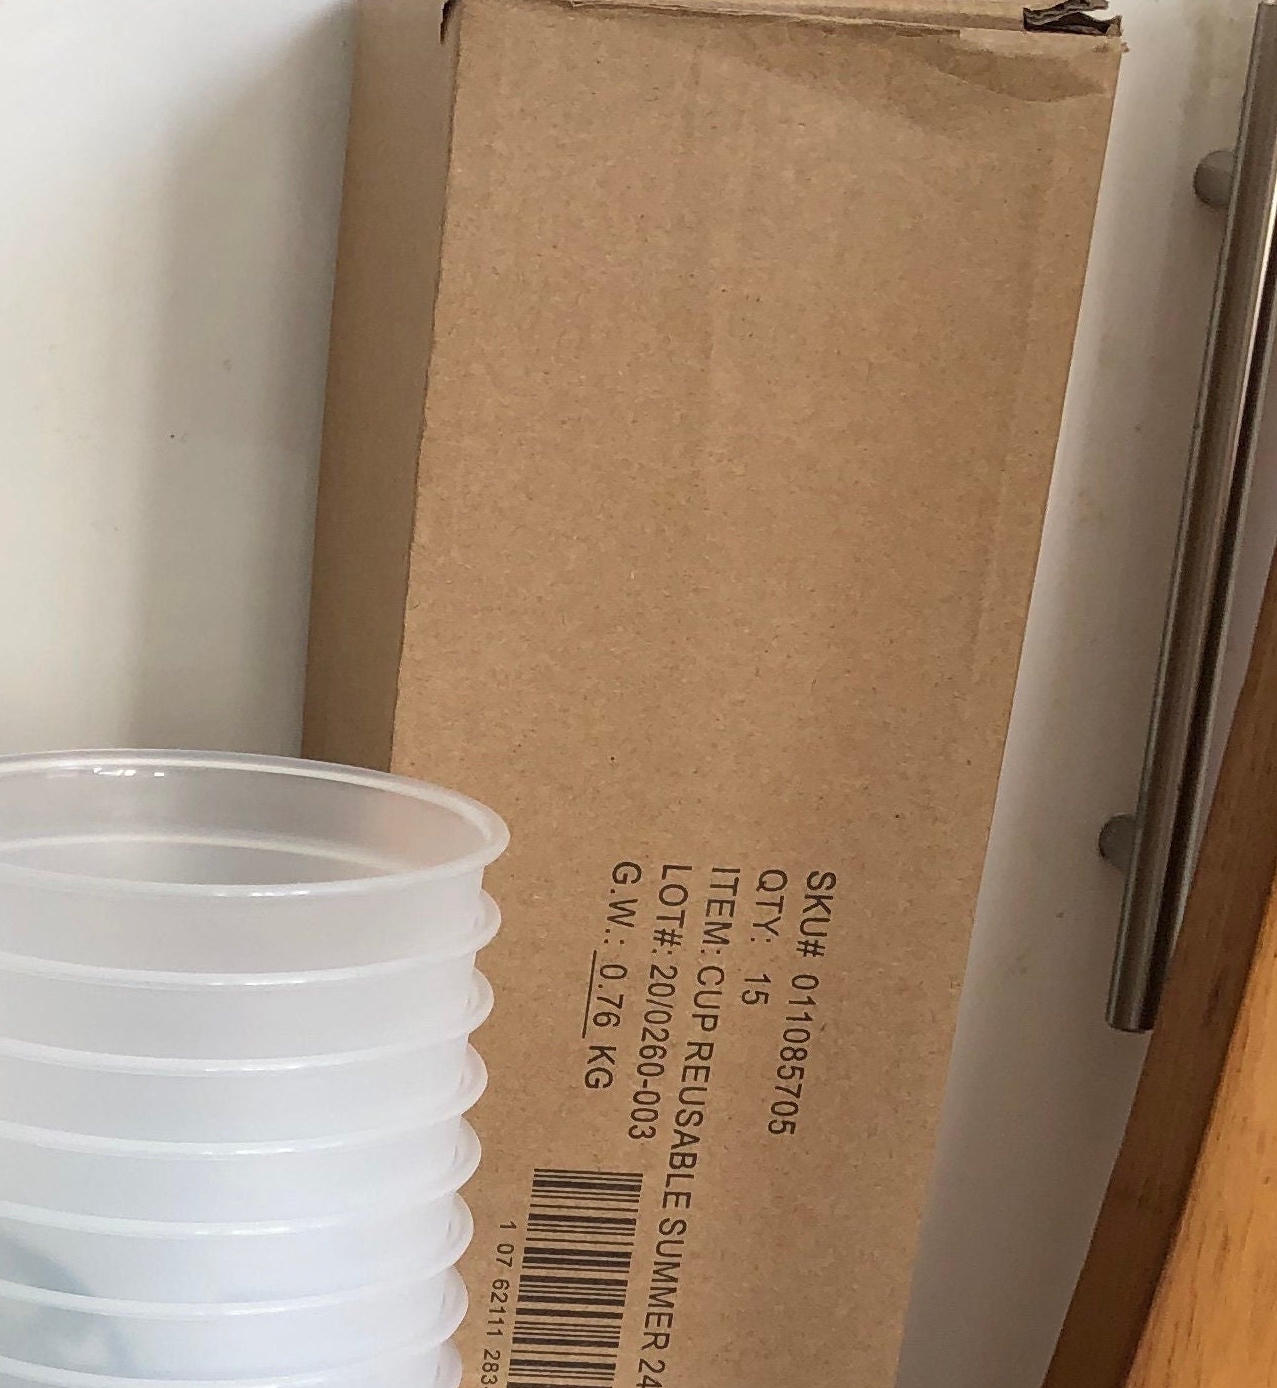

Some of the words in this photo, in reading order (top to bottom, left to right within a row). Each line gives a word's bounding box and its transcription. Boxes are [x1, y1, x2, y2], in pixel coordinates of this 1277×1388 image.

[604, 862, 642, 944] G.W.:
[651, 865, 692, 955] LOT#:
[701, 867, 740, 954] ITEM:
[751, 870, 788, 942] QTY:
[796, 871, 836, 957] SKU#
[593, 964, 628, 1027] 0.76
[692, 966, 724, 1032] CUP
[740, 973, 772, 1005] 15
[585, 1046, 616, 1089] KG
[629, 964, 678, 1141] 20/0260-003
[768, 974, 820, 1135] 011085705
[662, 1042, 714, 1209] REUSABLE
[496, 1244, 514, 1267] 07
[499, 1221, 517, 1230] 1
[487, 1279, 510, 1335] 62111
[641, 1218, 687, 1350] SUMMER
